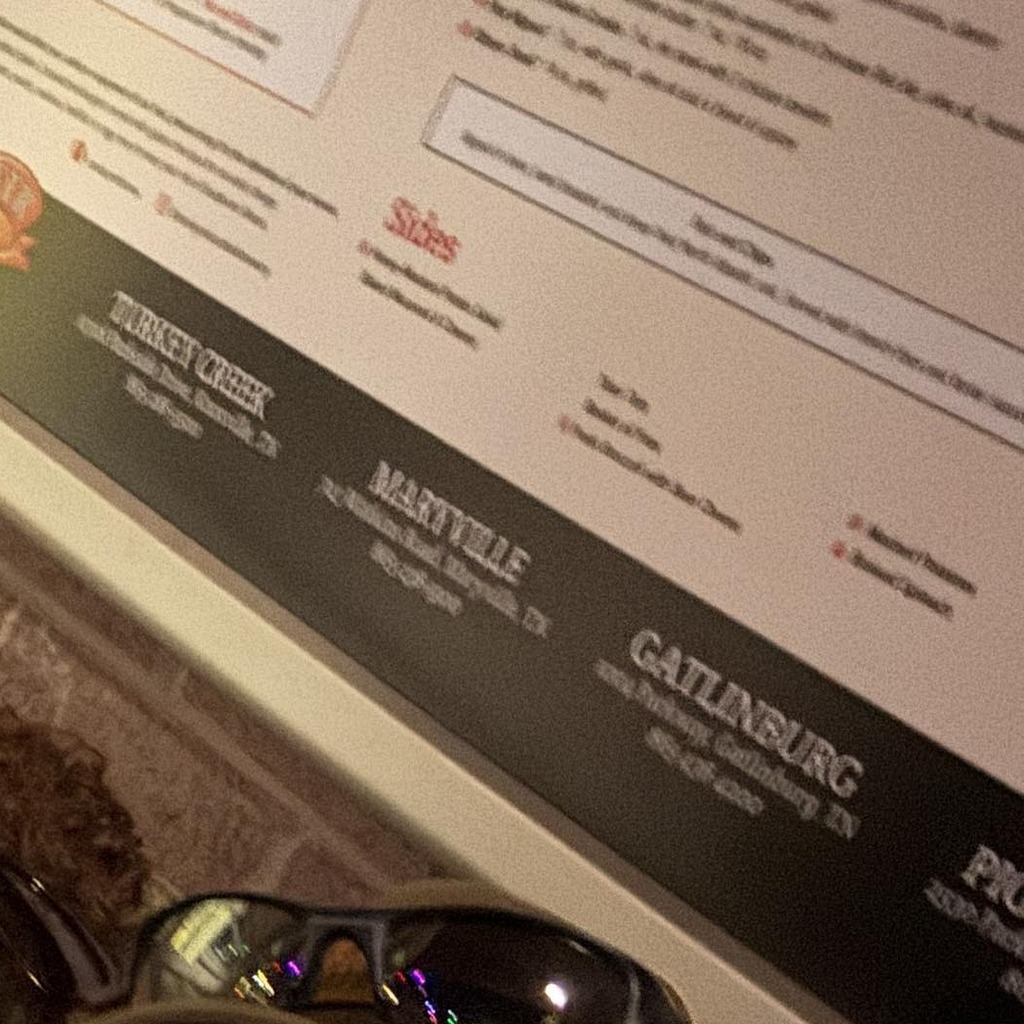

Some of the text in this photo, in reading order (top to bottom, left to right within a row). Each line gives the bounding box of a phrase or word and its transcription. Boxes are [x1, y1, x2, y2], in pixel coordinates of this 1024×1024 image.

[383, 196, 461, 265] Sides
[194, 347, 275, 421] CREEK
[367, 459, 531, 586] MARYVILLE
[629, 629, 864, 798] GATLINBURG
